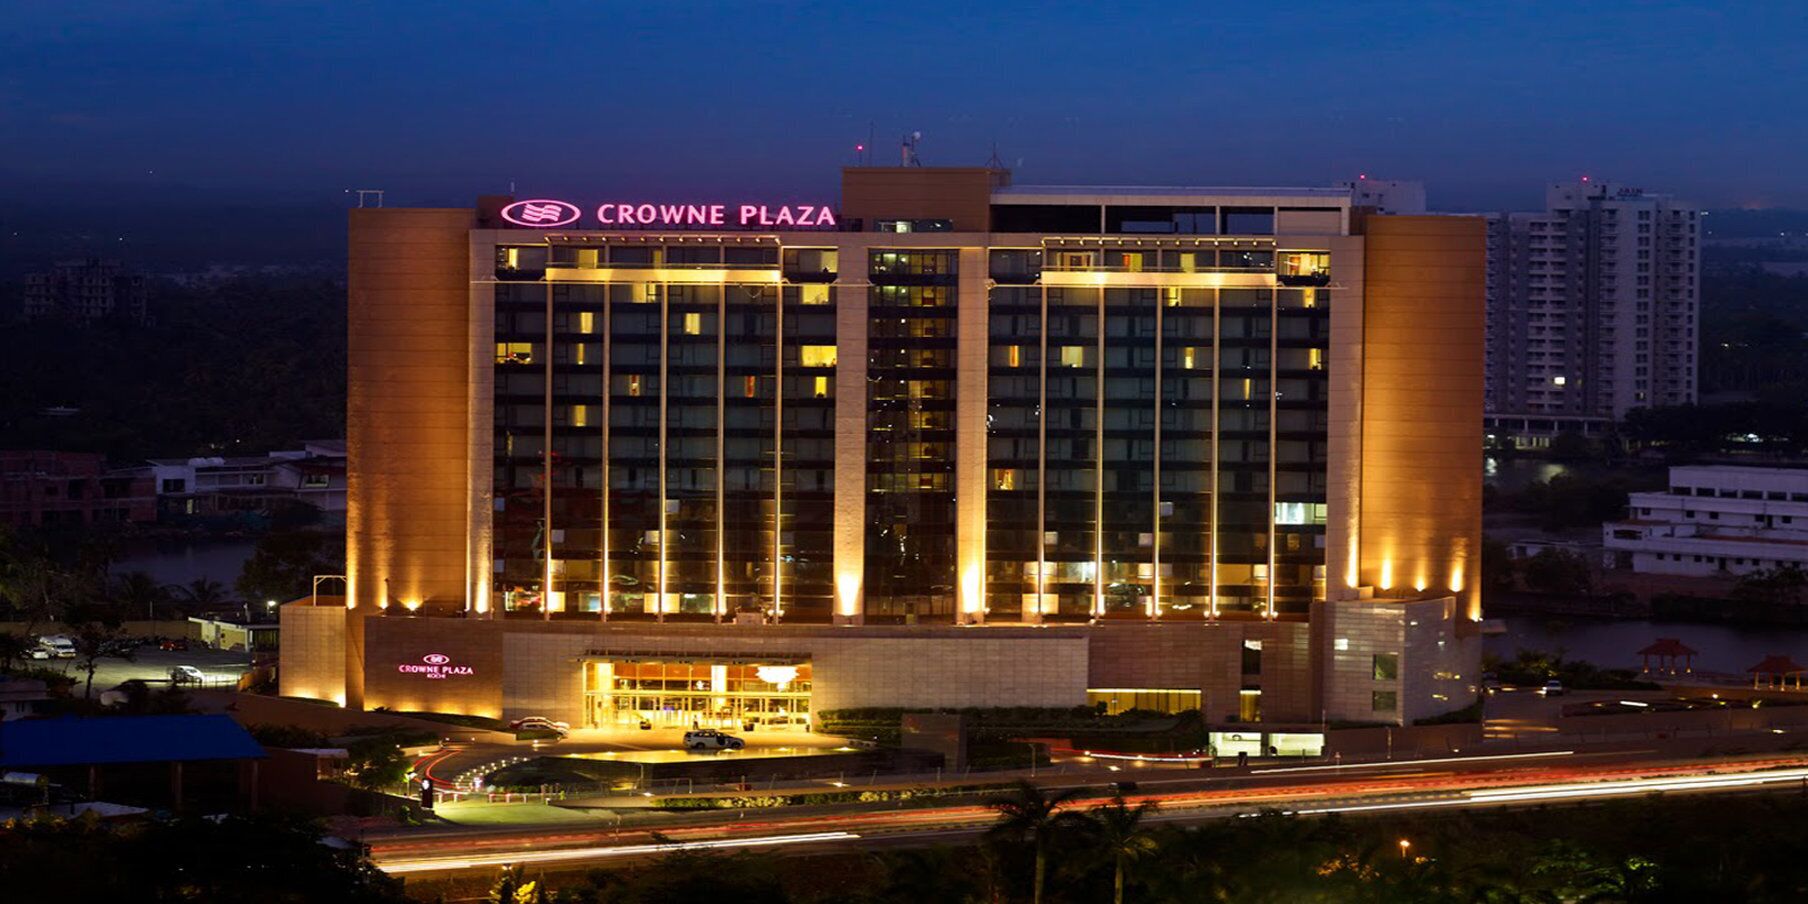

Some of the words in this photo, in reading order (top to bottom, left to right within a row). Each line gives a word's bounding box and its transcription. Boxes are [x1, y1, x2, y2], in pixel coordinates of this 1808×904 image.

[597, 203, 725, 225] CROWNE
[740, 205, 836, 225] PLAZA
[398, 665, 439, 673] CROWNE
[442, 666, 474, 675] PLAZA
